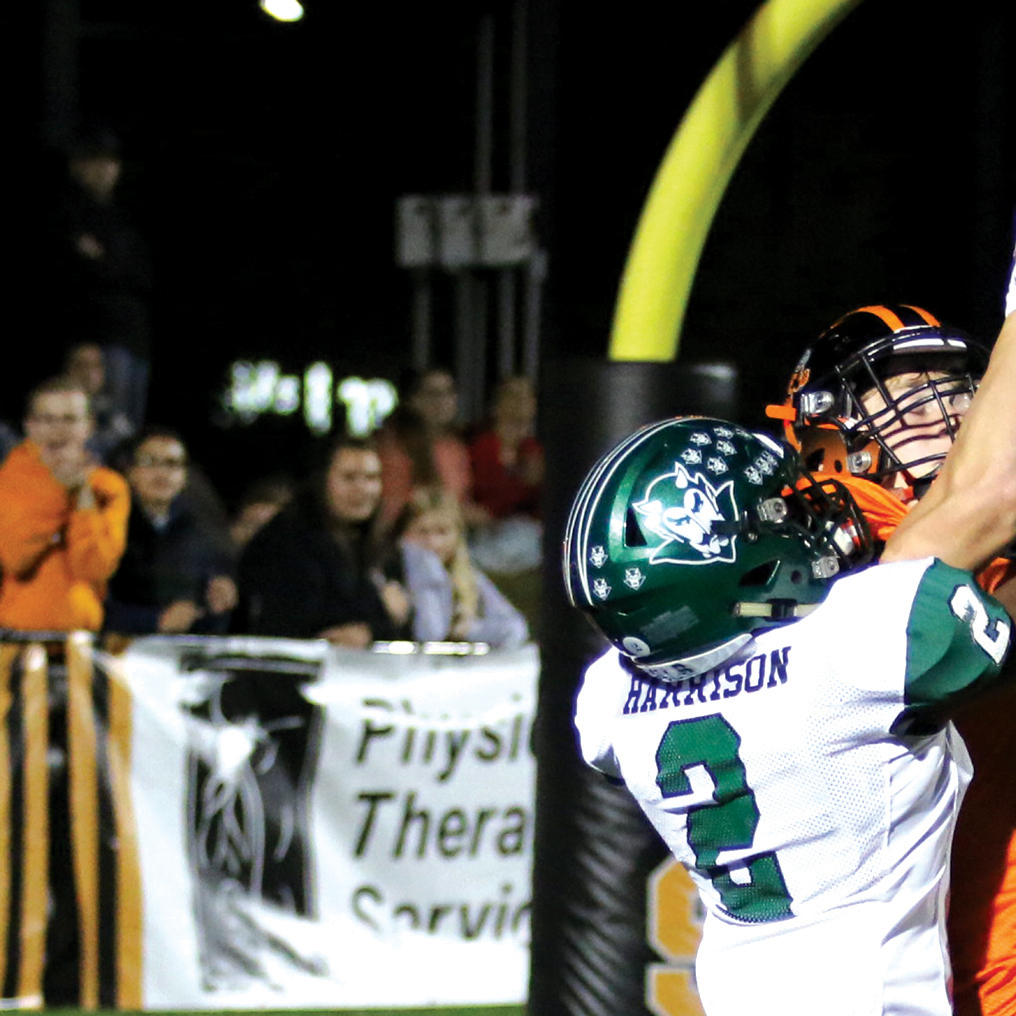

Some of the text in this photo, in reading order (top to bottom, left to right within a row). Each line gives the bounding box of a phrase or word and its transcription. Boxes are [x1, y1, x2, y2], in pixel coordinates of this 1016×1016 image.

[947, 584, 1010, 666] 2
[354, 790, 527, 859] Thera
[655, 712, 798, 924] 2
